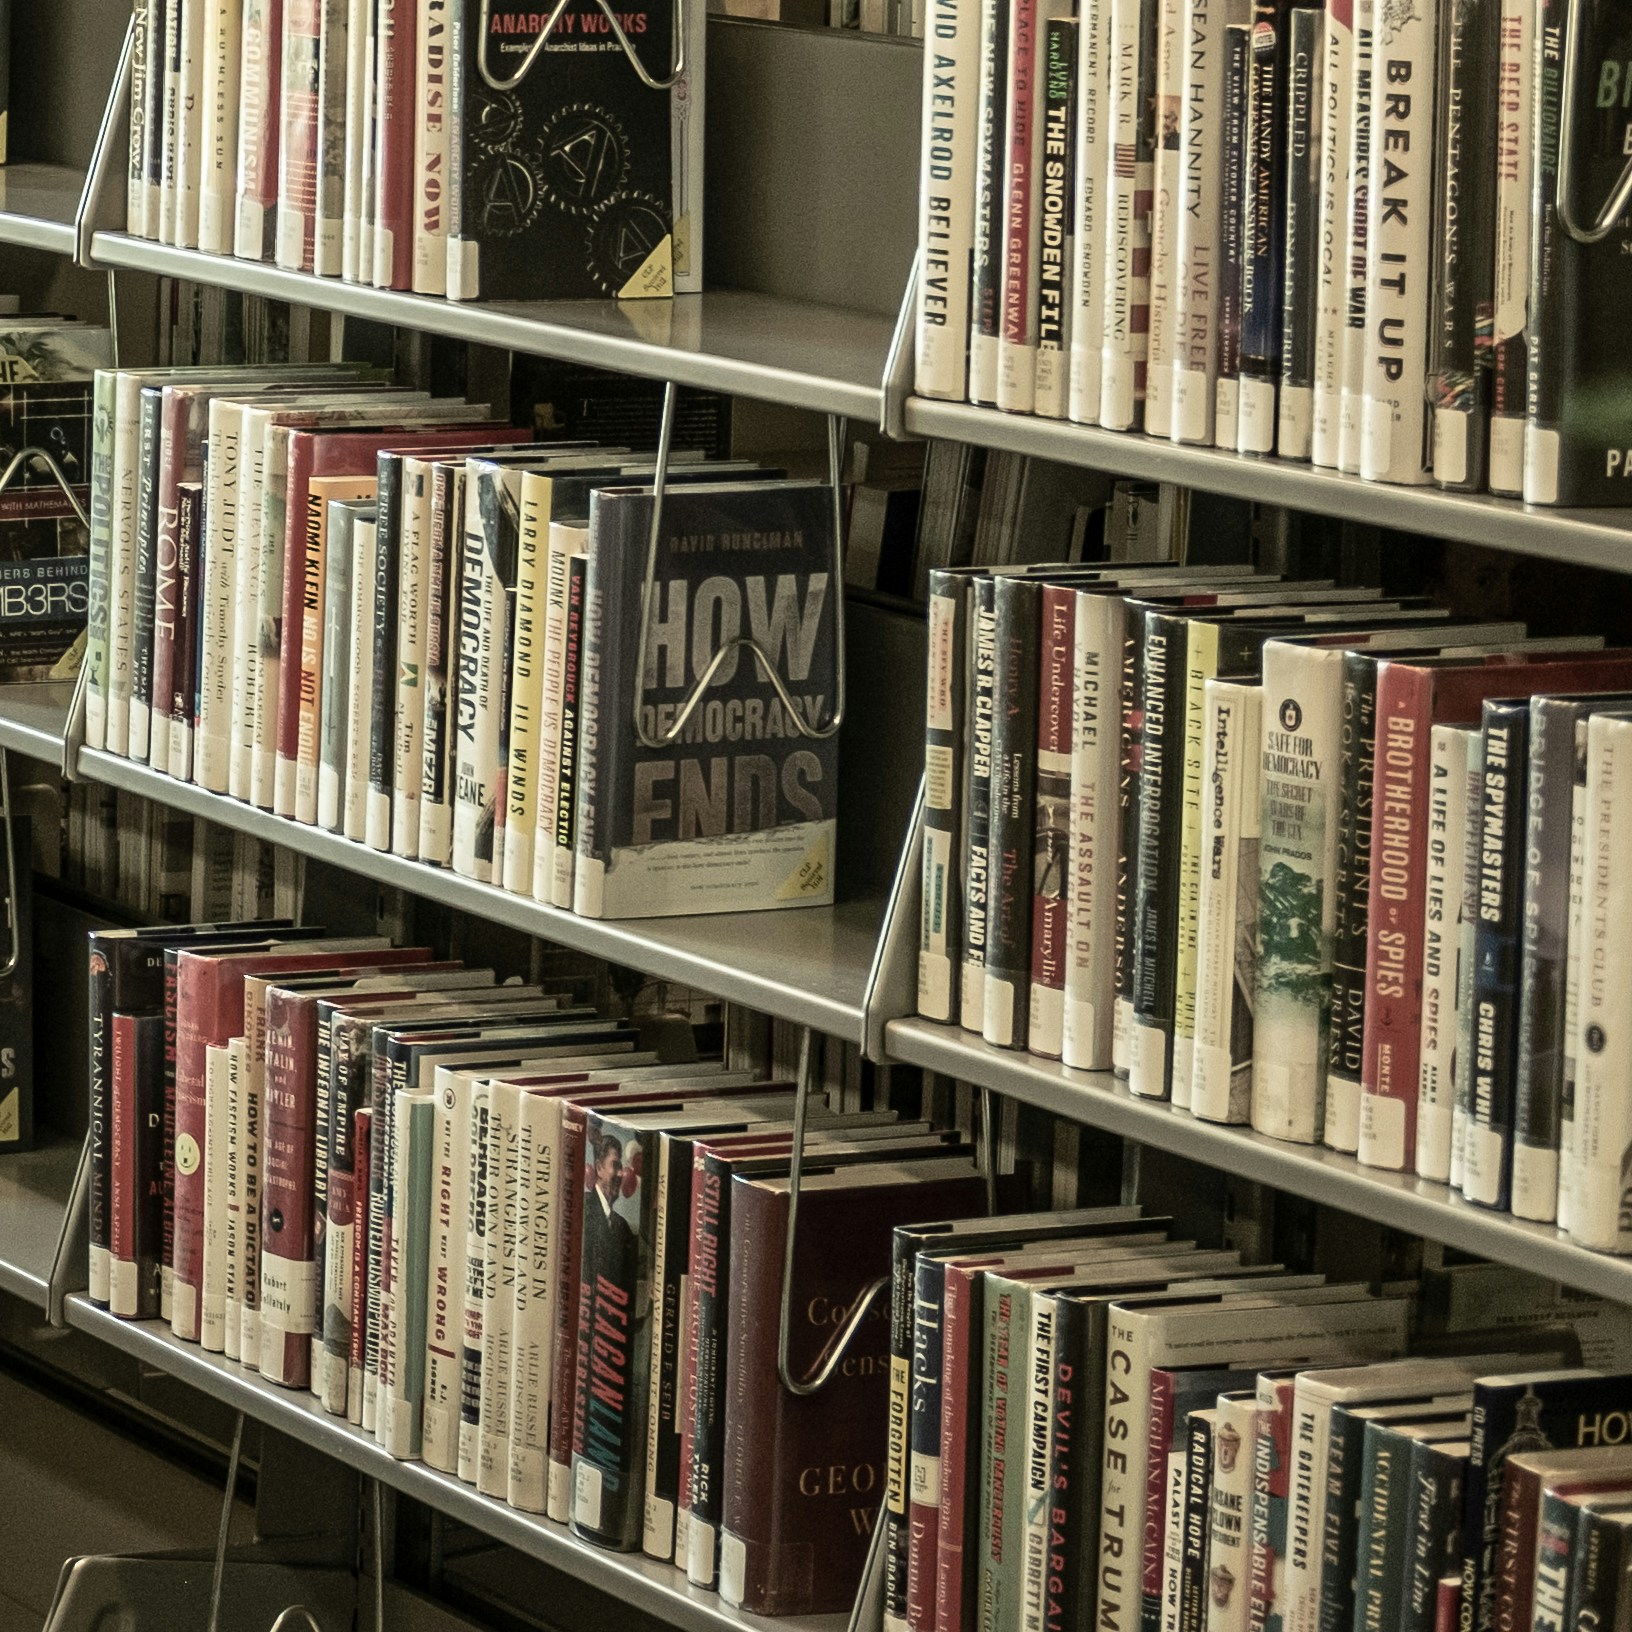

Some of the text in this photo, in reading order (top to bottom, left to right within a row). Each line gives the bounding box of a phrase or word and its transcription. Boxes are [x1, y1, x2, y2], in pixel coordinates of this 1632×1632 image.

[929, 53, 956, 182] AXELROD
[1186, 83, 1204, 219] HANNITY
[423, 153, 443, 236] NOW
[1378, 61, 1411, 382] BREAK IT UP
[924, 196, 950, 327] BELIEVER
[36, 565, 88, 579] BEHIND
[156, 506, 178, 641] ROME
[517, 500, 538, 678] LARRY DIAMOND
[641, 574, 829, 689] HOW
[457, 532, 484, 742] DEMOCRACY
[638, 694, 825, 747] DEMOCRACY
[1082, 651, 1099, 752] MICHAEL
[635, 750, 824, 848] ENDS
[1209, 704, 1231, 881] Intelligence Wars
[1376, 715, 1414, 998] BROTHERHOOD SPIES
[1480, 725, 1509, 922] THE SPYMASTERS
[1476, 1000, 1497, 1070] CHRIS
[913, 1301, 938, 1413] Hacks
[1112, 1326, 1133, 1342] THE
[888, 1392, 904, 1504] FORGOTTEN
[1106, 1354, 1132, 1474] CASE
[1187, 1431, 1206, 1558] RADICAL HOPE
[1251, 1438, 1270, 1599] INDISPENSABLE
[1292, 1413, 1314, 1570] THE GATEKEEPERS
